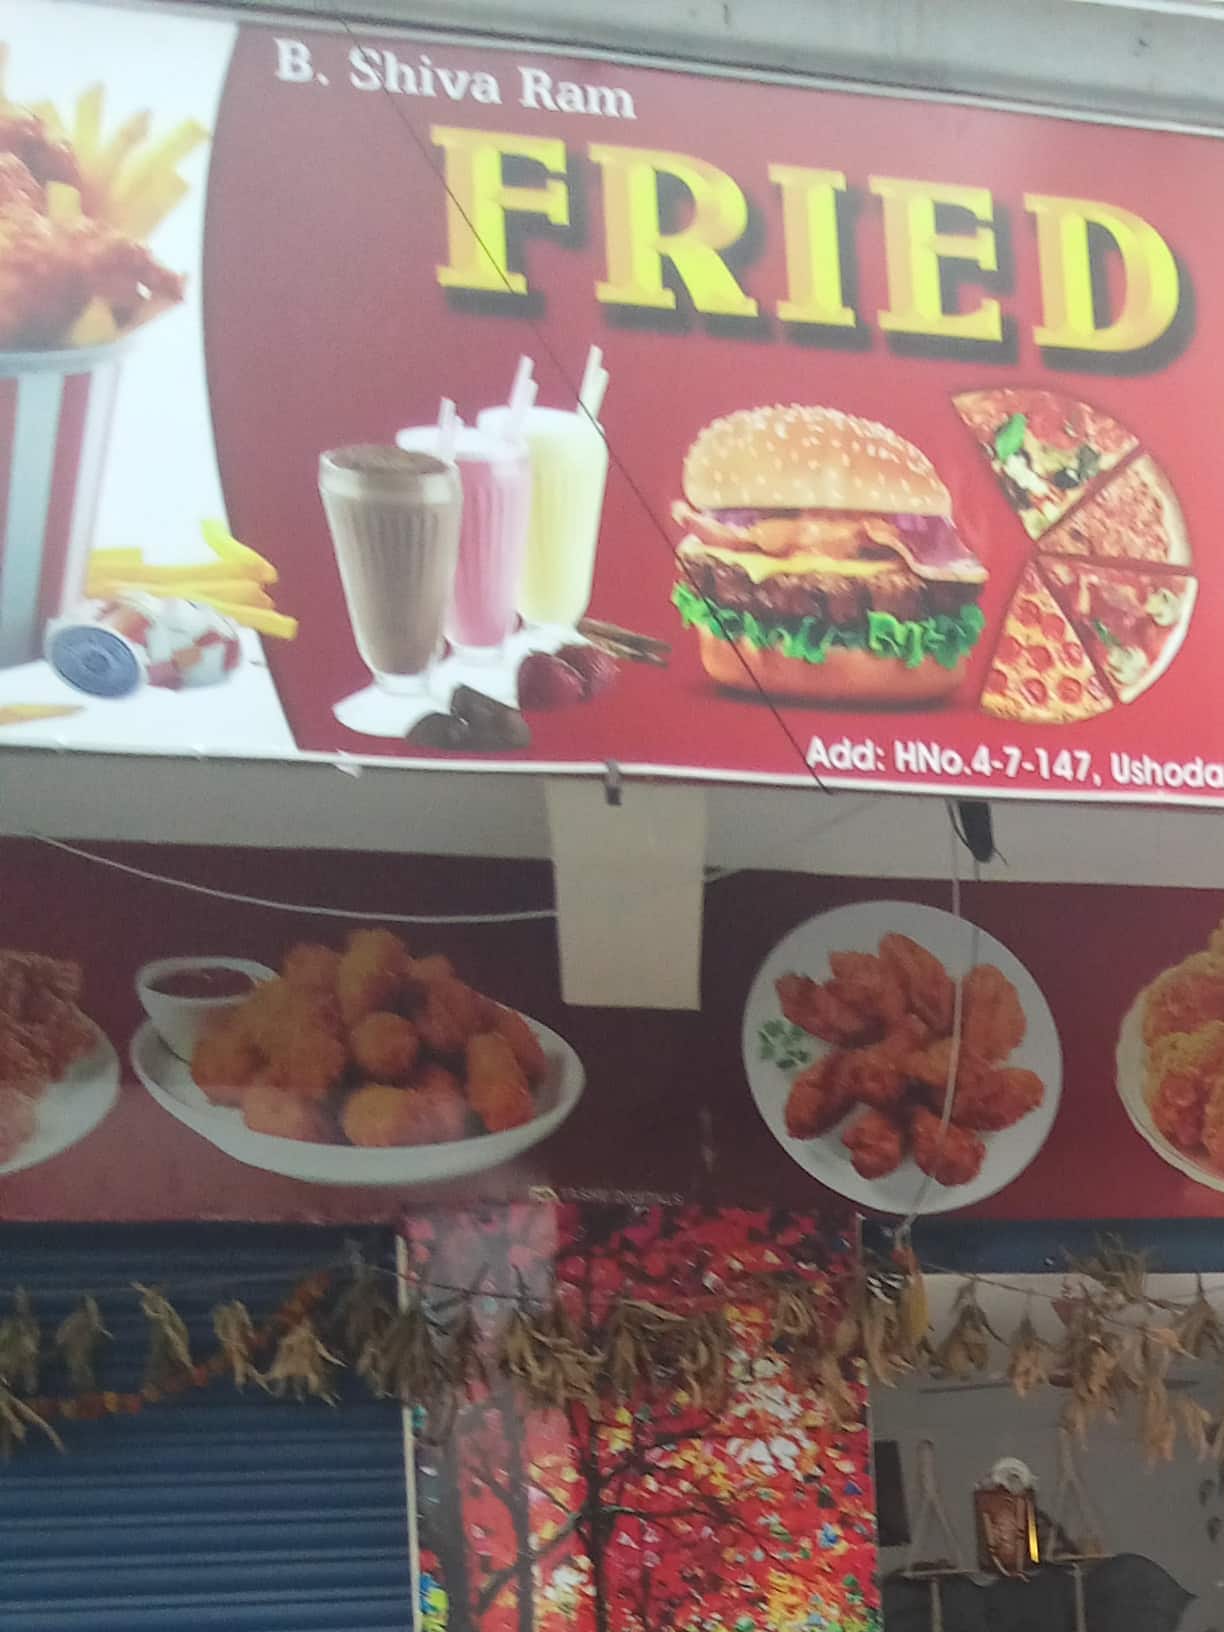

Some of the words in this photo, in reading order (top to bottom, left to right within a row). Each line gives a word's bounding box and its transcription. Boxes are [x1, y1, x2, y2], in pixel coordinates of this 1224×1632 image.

[274, 37, 329, 86] B.
[349, 46, 503, 105] Shiva
[517, 65, 637, 119] Ram
[430, 123, 1180, 354] FRIED
[805, 735, 886, 772] Add:
[894, 740, 1101, 785] HNo.4-7-147,
